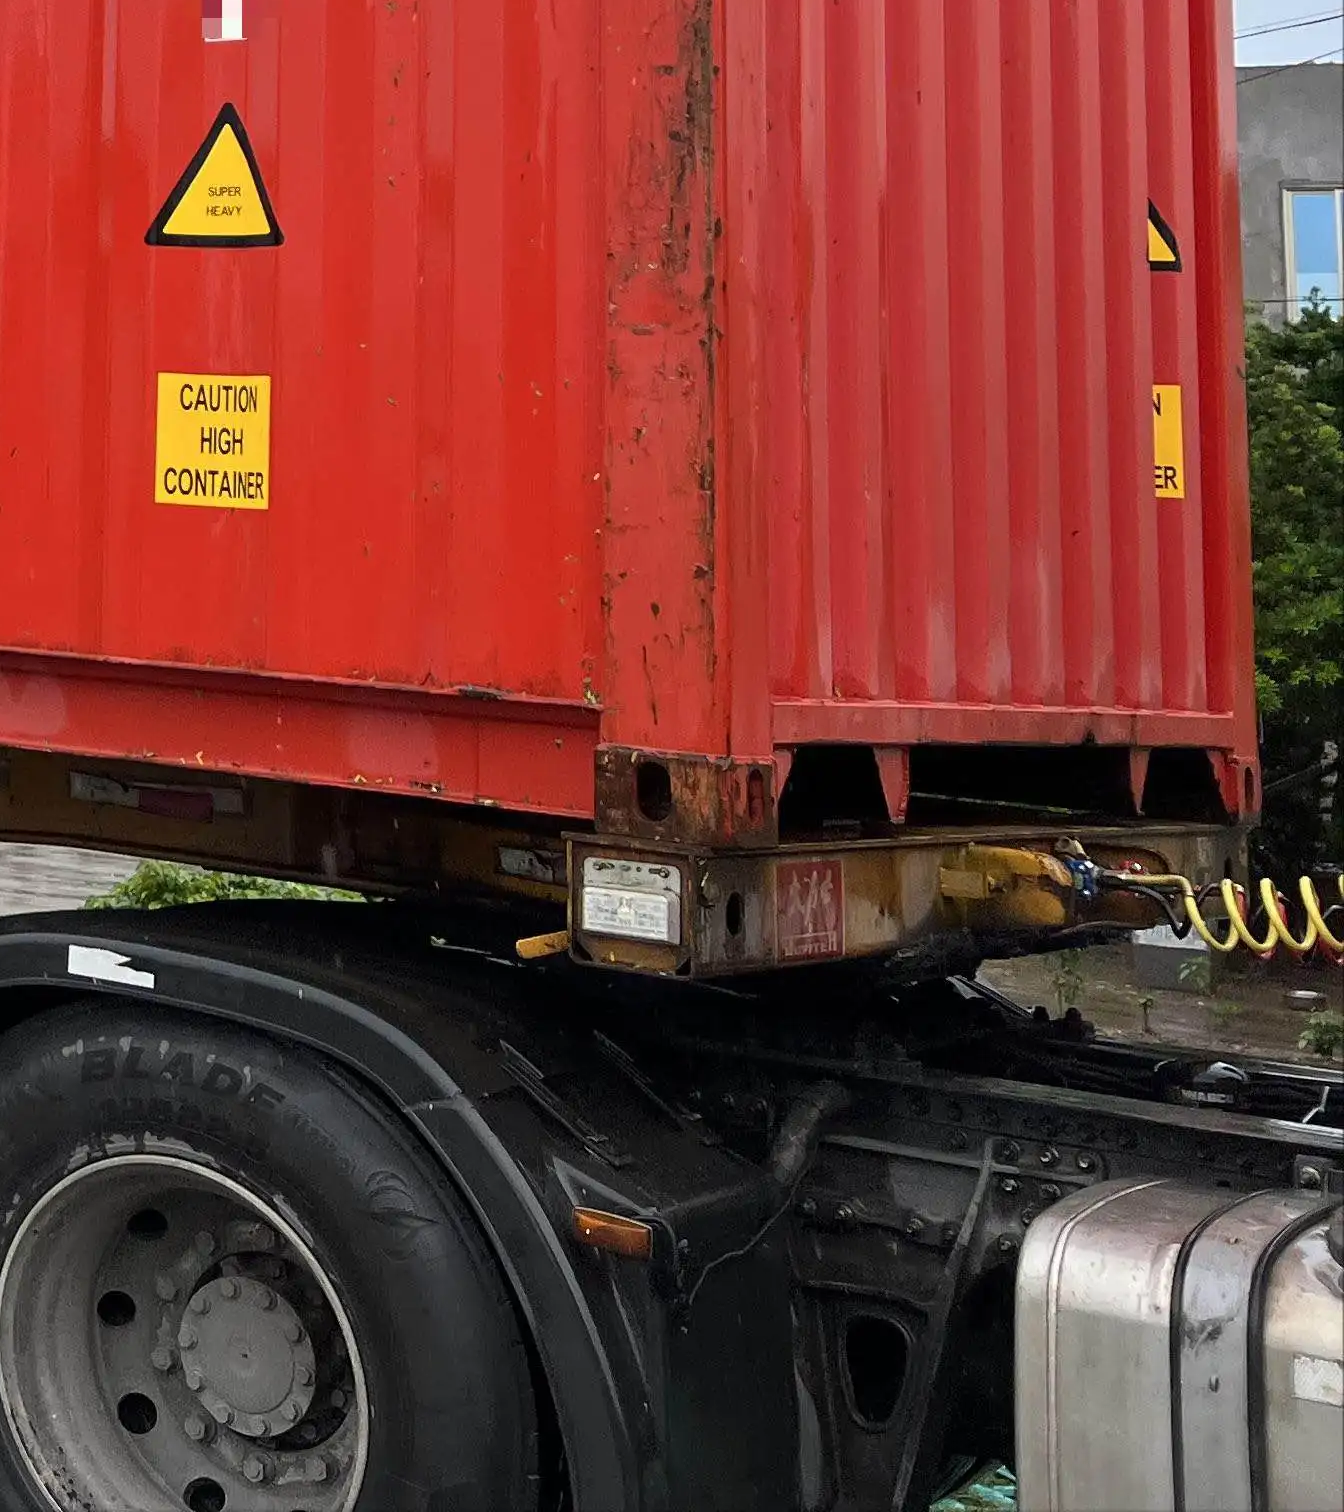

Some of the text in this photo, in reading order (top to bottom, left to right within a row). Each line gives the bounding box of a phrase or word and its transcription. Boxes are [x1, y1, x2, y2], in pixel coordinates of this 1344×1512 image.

[208, 186, 242, 197] SUPER
[206, 205, 242, 217] HEAVY
[179, 383, 258, 413] CAUTION
[200, 426, 244, 456] HIGH
[163, 466, 265, 500] CONTAINER
